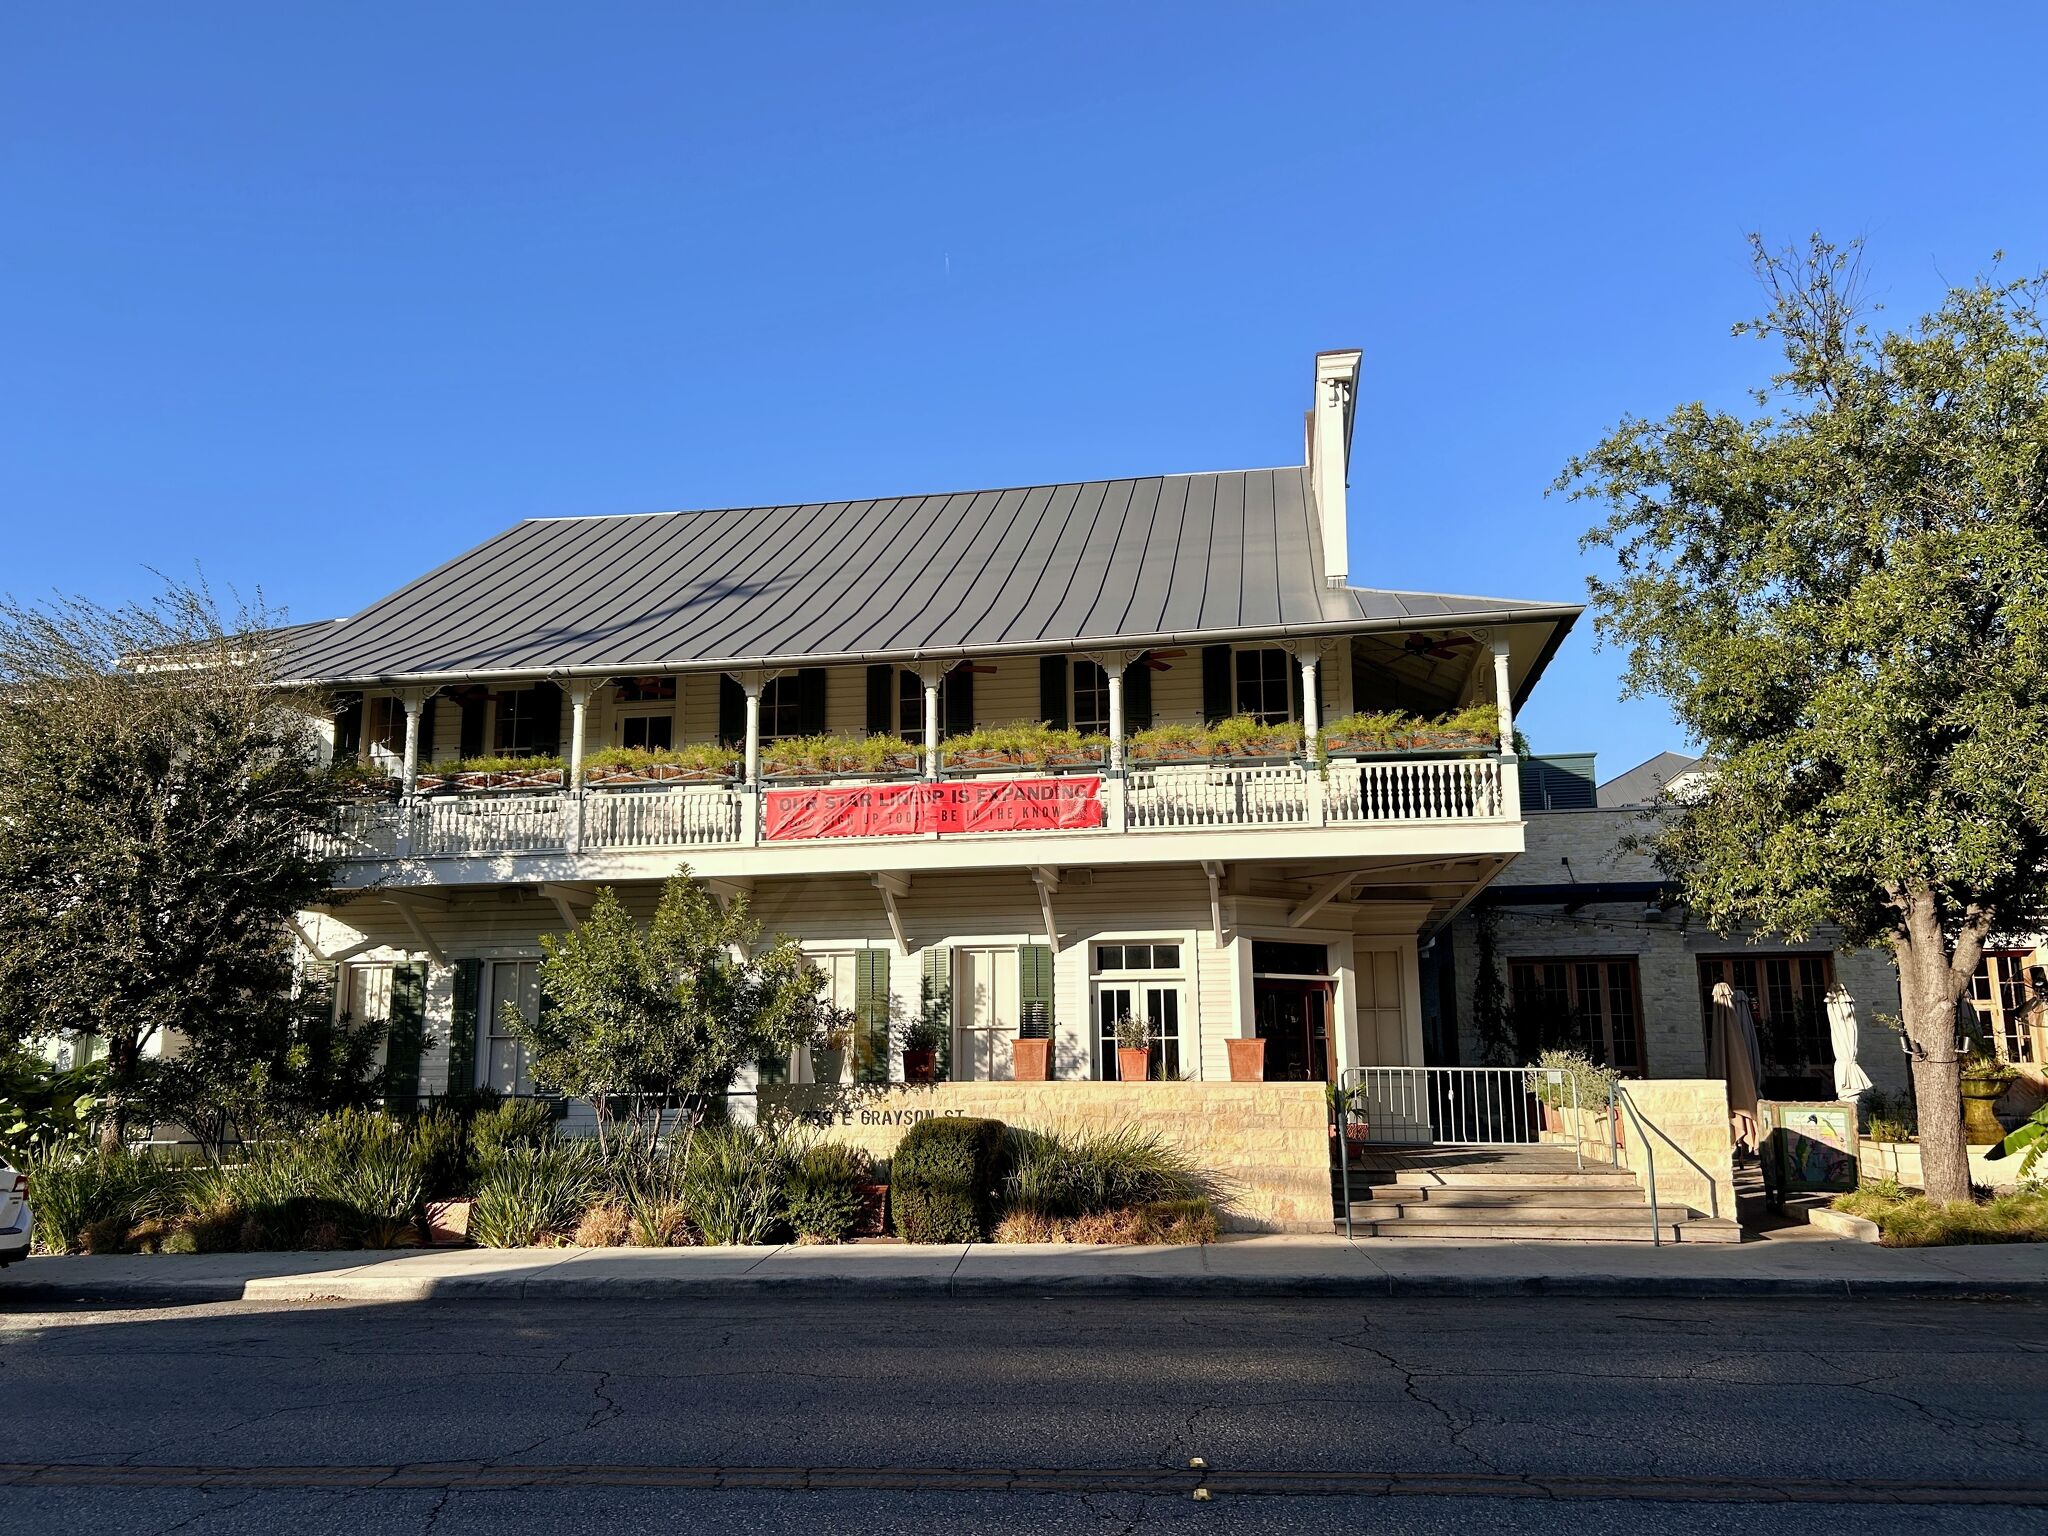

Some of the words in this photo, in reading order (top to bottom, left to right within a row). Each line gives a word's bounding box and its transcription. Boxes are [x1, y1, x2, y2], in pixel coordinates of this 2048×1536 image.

[779, 795, 817, 811] OUR
[825, 793, 873, 809] STAR
[879, 789, 944, 808] LINEUP
[951, 789, 969, 804] IS
[977, 784, 1088, 803] EXPANDING
[823, 813, 854, 827] SIGN
[863, 813, 879, 825] UP
[966, 808, 980, 821] IN
[989, 807, 1013, 820] THE
[1022, 805, 1061, 818] KNOW
[842, 1110, 852, 1126] E
[861, 1109, 935, 1126] GRAYSON
